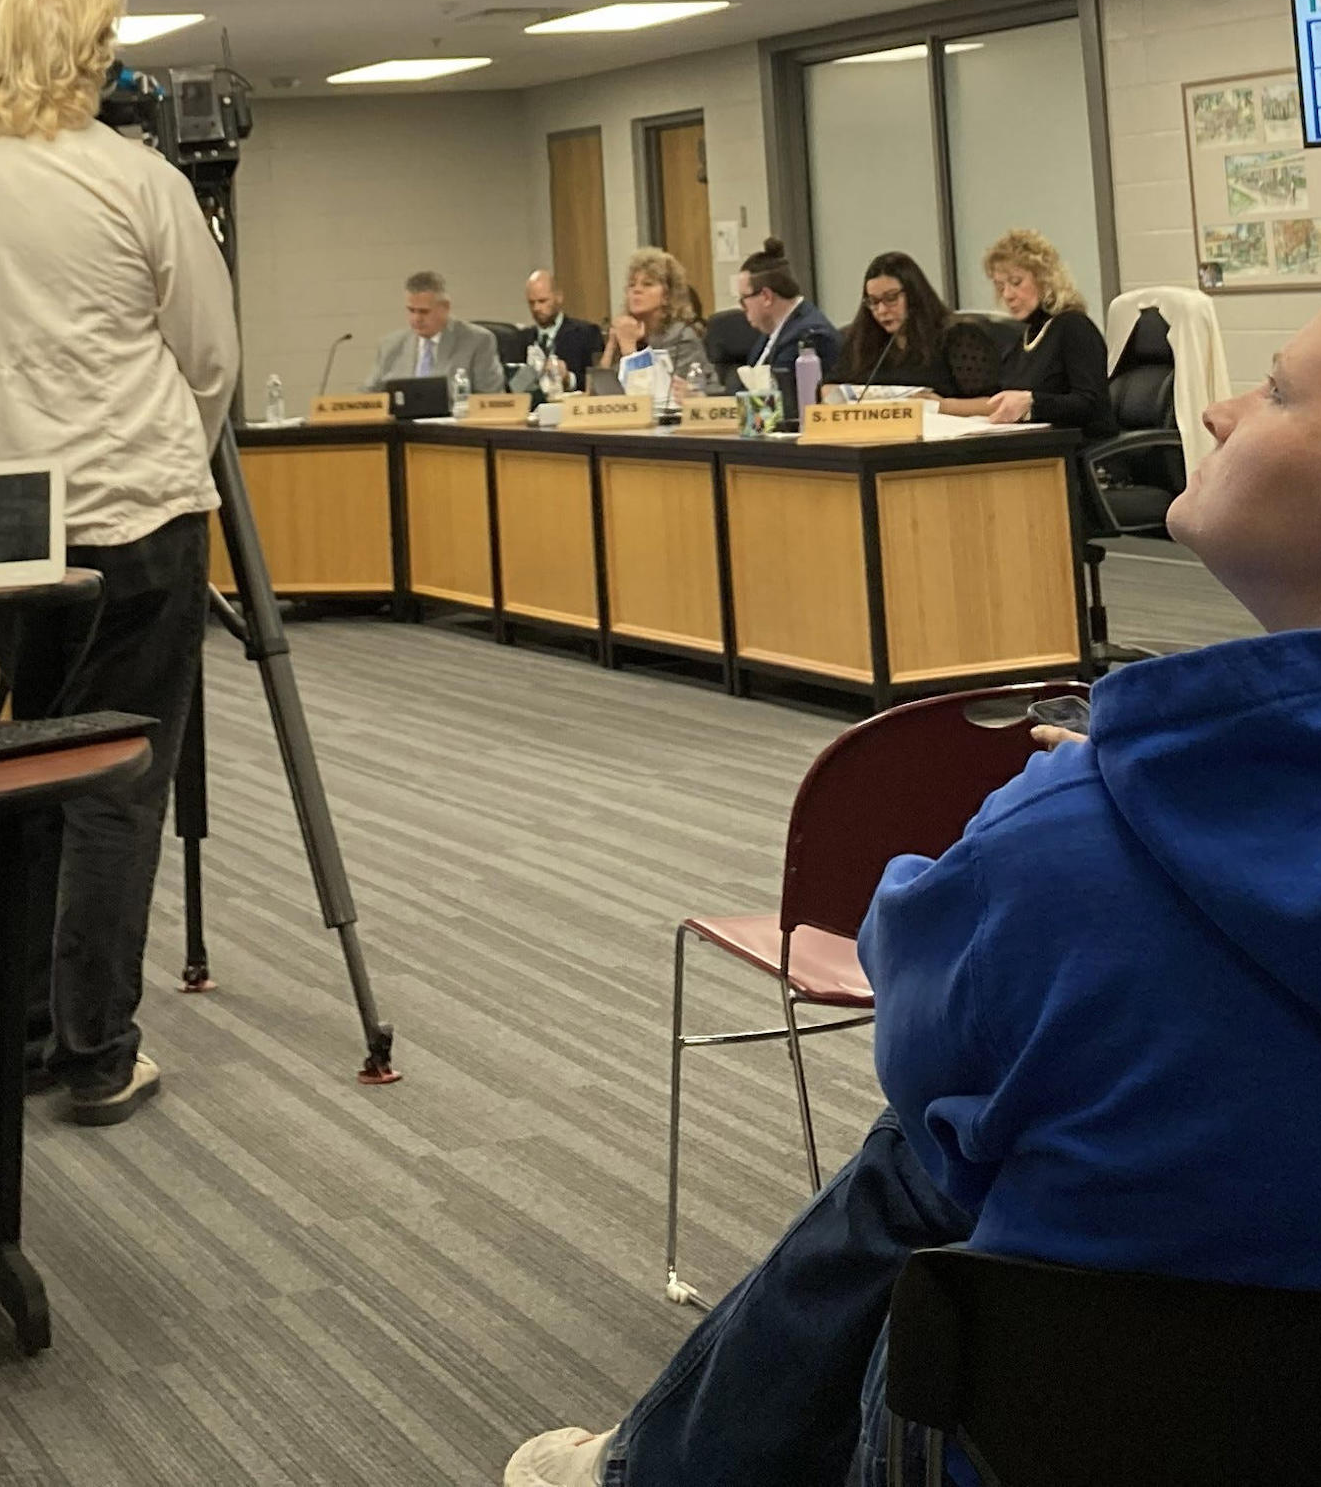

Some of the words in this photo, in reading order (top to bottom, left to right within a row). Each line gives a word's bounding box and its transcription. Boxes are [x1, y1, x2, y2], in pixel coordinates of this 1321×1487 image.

[573, 405, 583, 417] E.
[587, 402, 638, 416] BROOKS
[690, 408, 704, 421] N.
[709, 406, 737, 421] GRE
[812, 411, 827, 423] S.
[832, 408, 913, 422] ETTINGER
